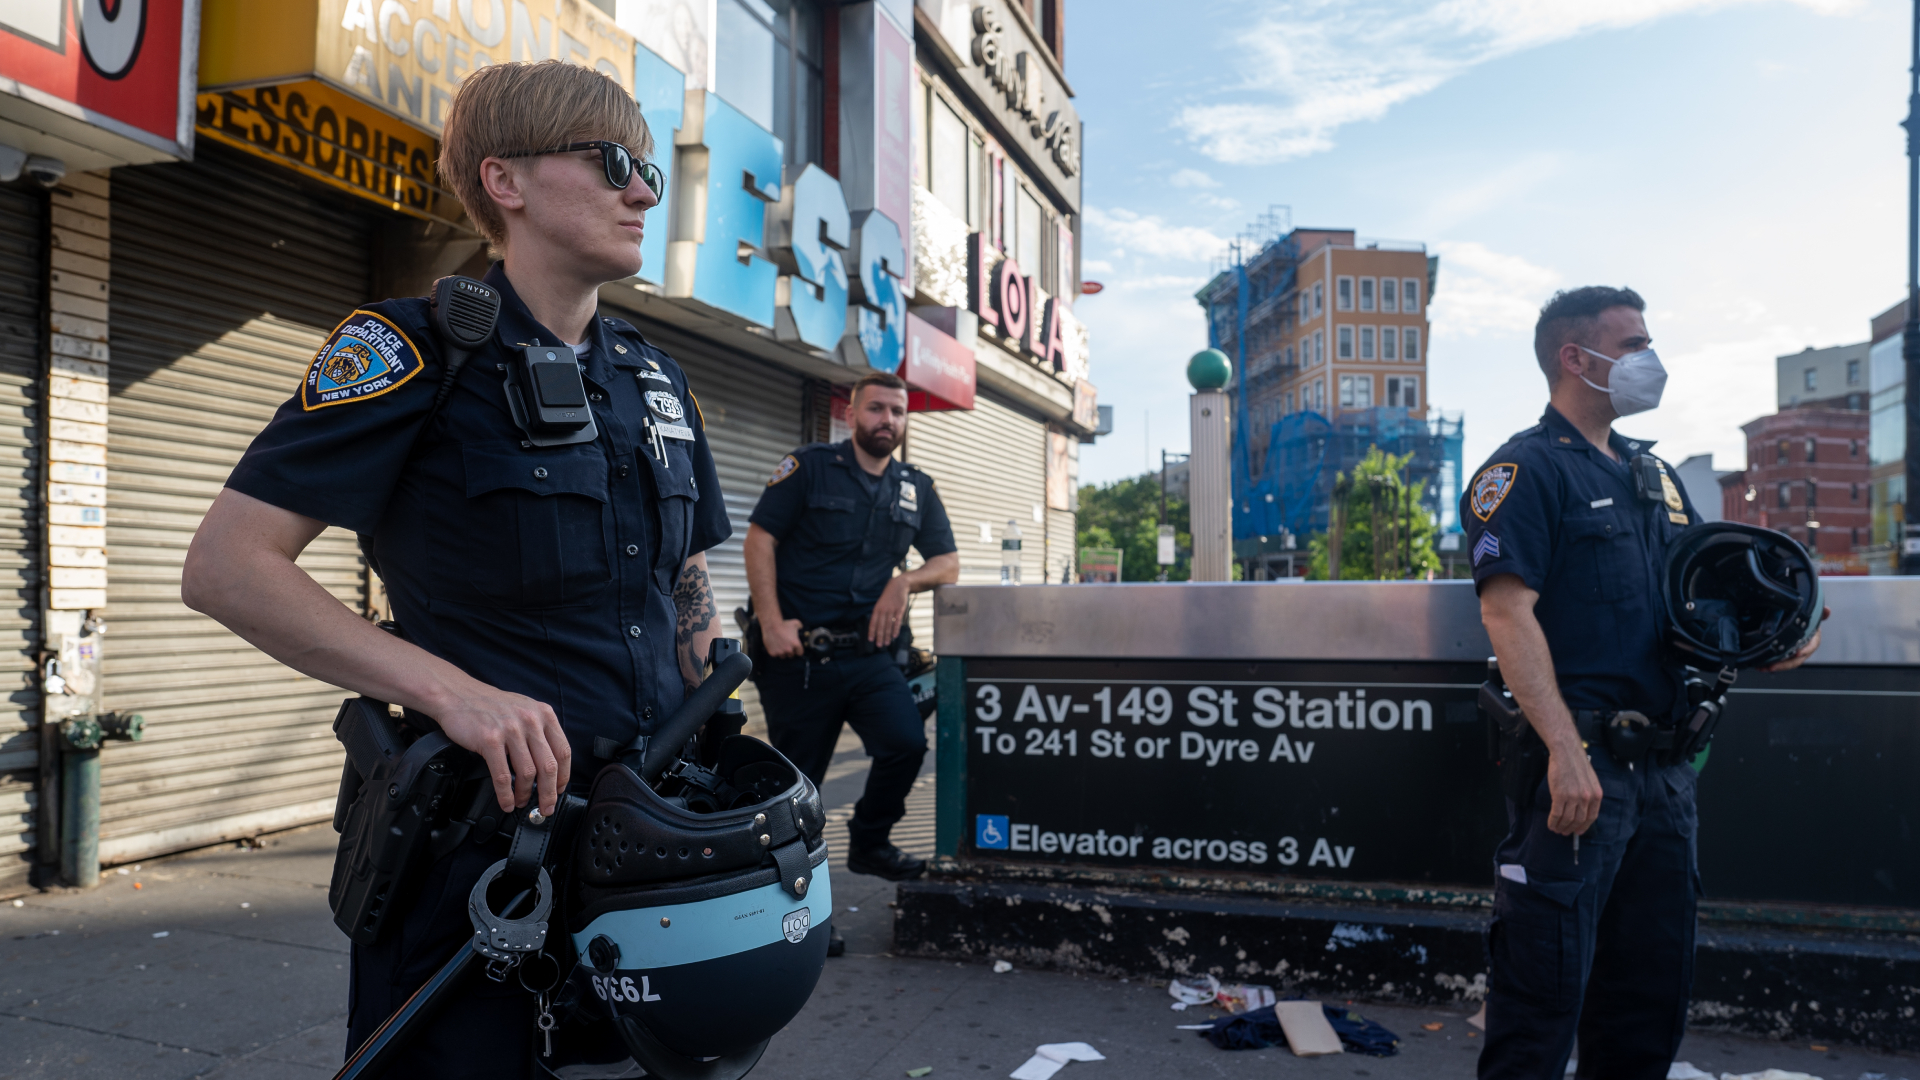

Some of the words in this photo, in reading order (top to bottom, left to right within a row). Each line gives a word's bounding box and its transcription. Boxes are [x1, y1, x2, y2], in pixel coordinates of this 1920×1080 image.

[467, 283, 490, 297] NYPD
[973, 231, 1067, 372] LOLA
[341, 324, 405, 374] DEPARTMENT
[363, 319, 404, 352] POLICE
[313, 344, 332, 369] CITY
[307, 371, 318, 386] OF
[321, 388, 351, 402] NEW
[352, 376, 393, 395] YORK
[975, 684, 1002, 723] 3
[1013, 685, 1173, 726] Av-149
[1187, 686, 1238, 727] St
[1252, 687, 1433, 731] Station
[975, 727, 1017, 755] To
[1025, 727, 1077, 757] 241
[1090, 728, 1126, 758] St
[1134, 735, 1171, 759] or
[1180, 731, 1260, 767] Dyre
[1268, 733, 1315, 764] Av
[1010, 823, 1144, 858] Elevator
[1151, 835, 1268, 864] across
[1277, 836, 1299, 866] 3
[1307, 837, 1355, 869] Av
[785, 914, 809, 935] DOT
[591, 975, 662, 1003] 7939
